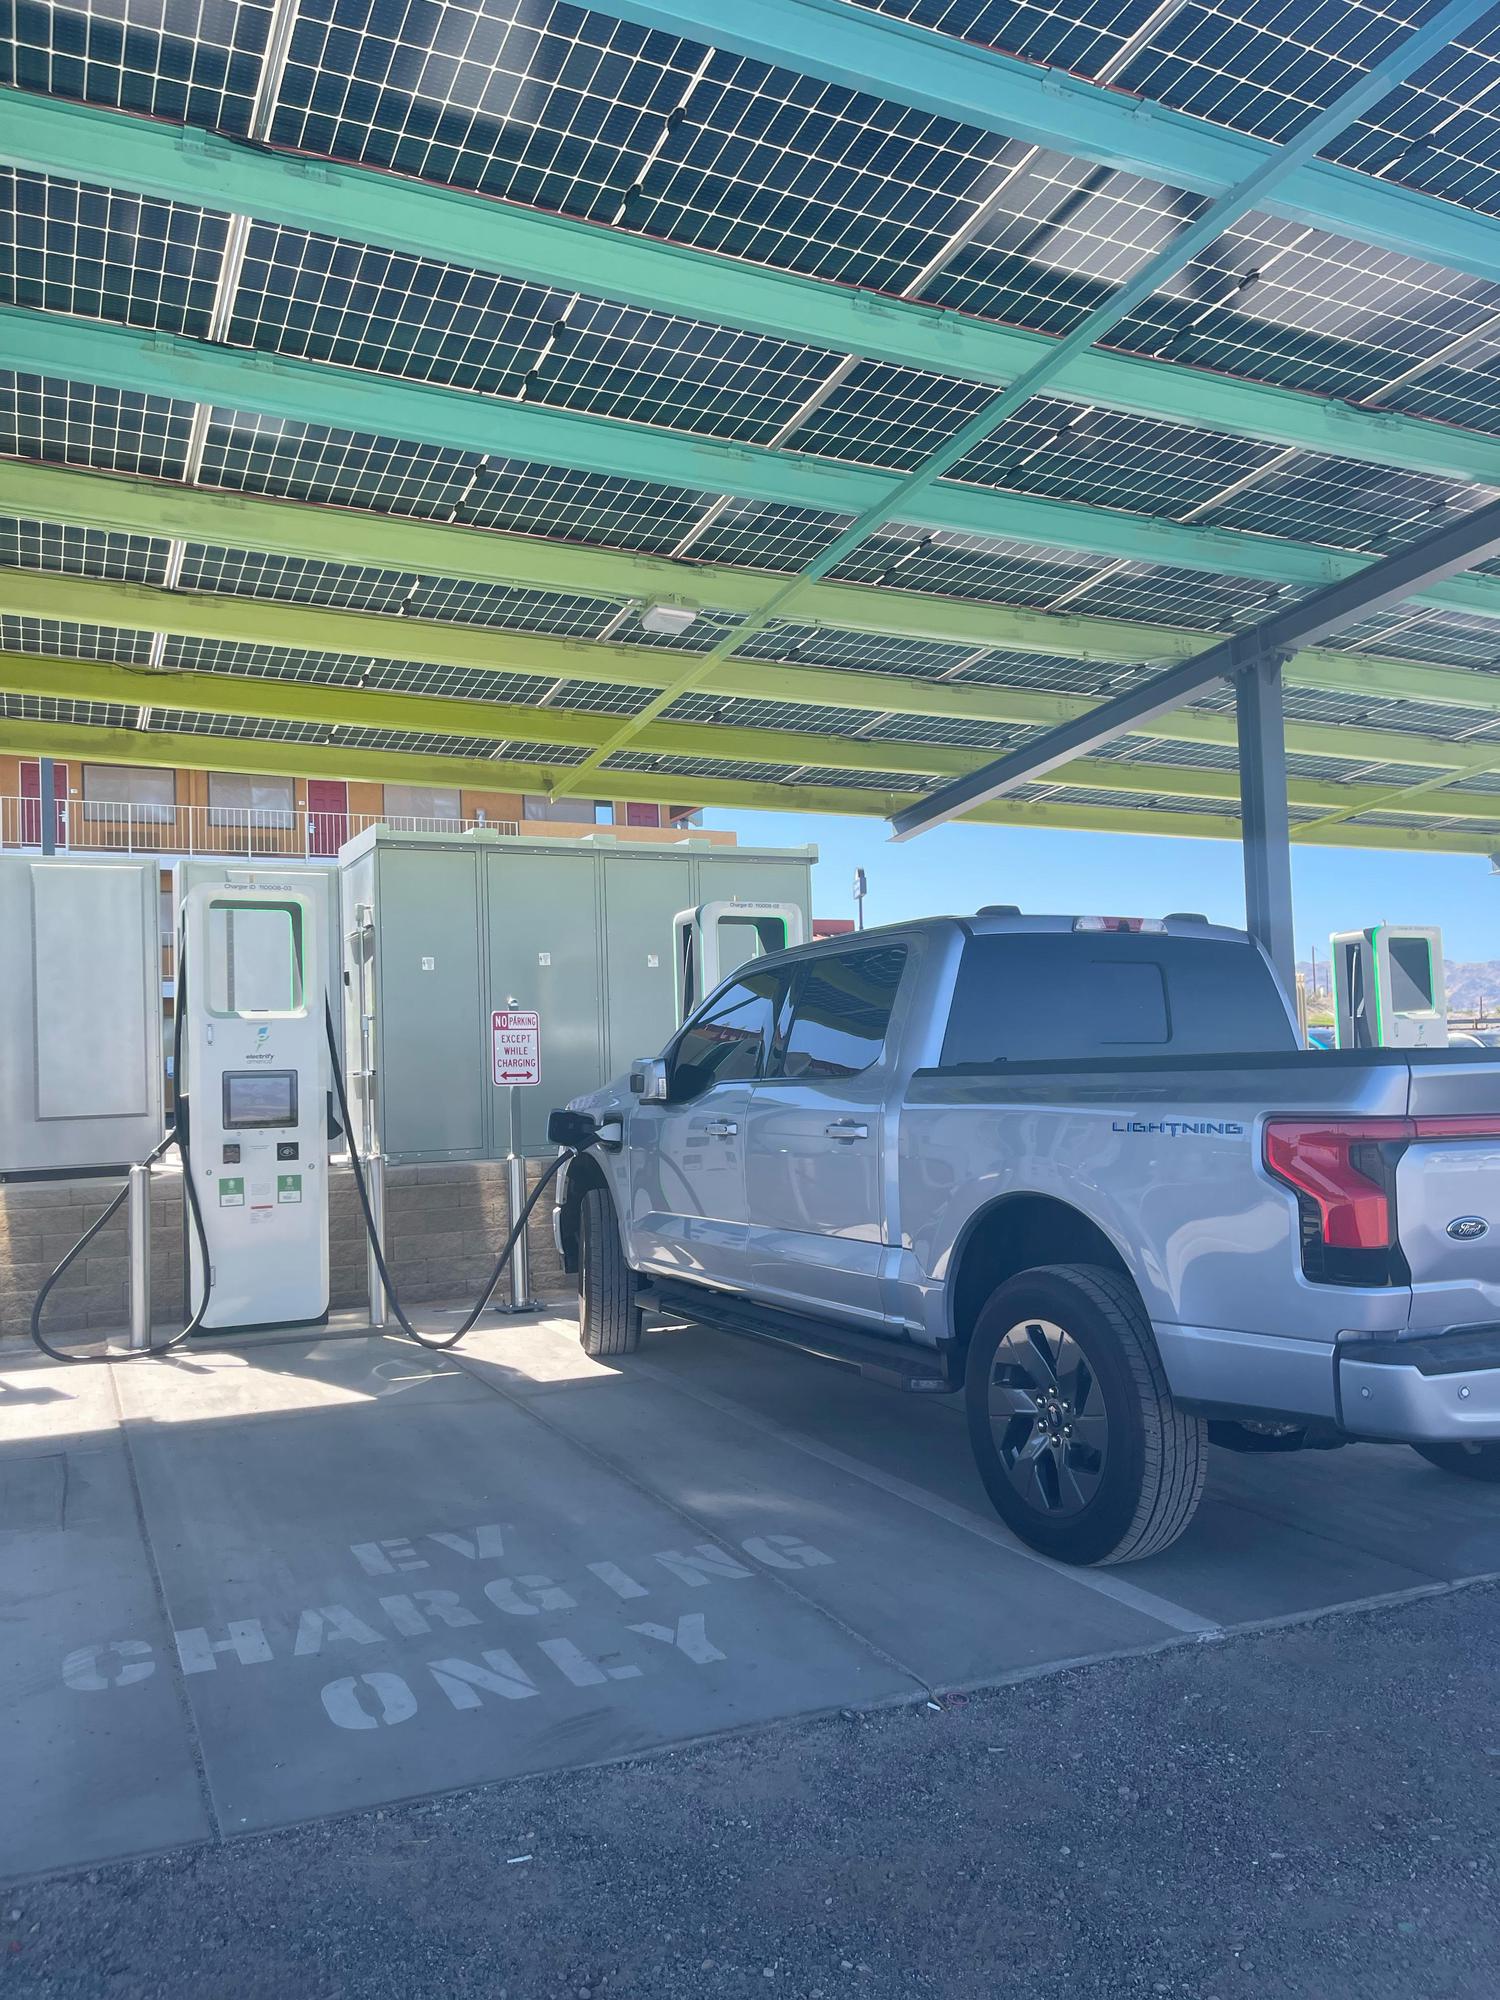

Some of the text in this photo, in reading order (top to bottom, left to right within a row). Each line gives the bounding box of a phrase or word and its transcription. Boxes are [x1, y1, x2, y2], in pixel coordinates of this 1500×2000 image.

[495, 1015, 536, 1028] NO PARKING
[501, 1034, 531, 1043] EXCEPT
[246, 1053, 274, 1061] electrify
[503, 1046, 528, 1055] WHILE
[497, 1058, 536, 1068] CHARGING
[1112, 1121, 1243, 1137] LIGHTNING
[350, 1524, 504, 1576] EV
[61, 1534, 837, 1691] CHARGING
[320, 1613, 728, 1730] ONLY
